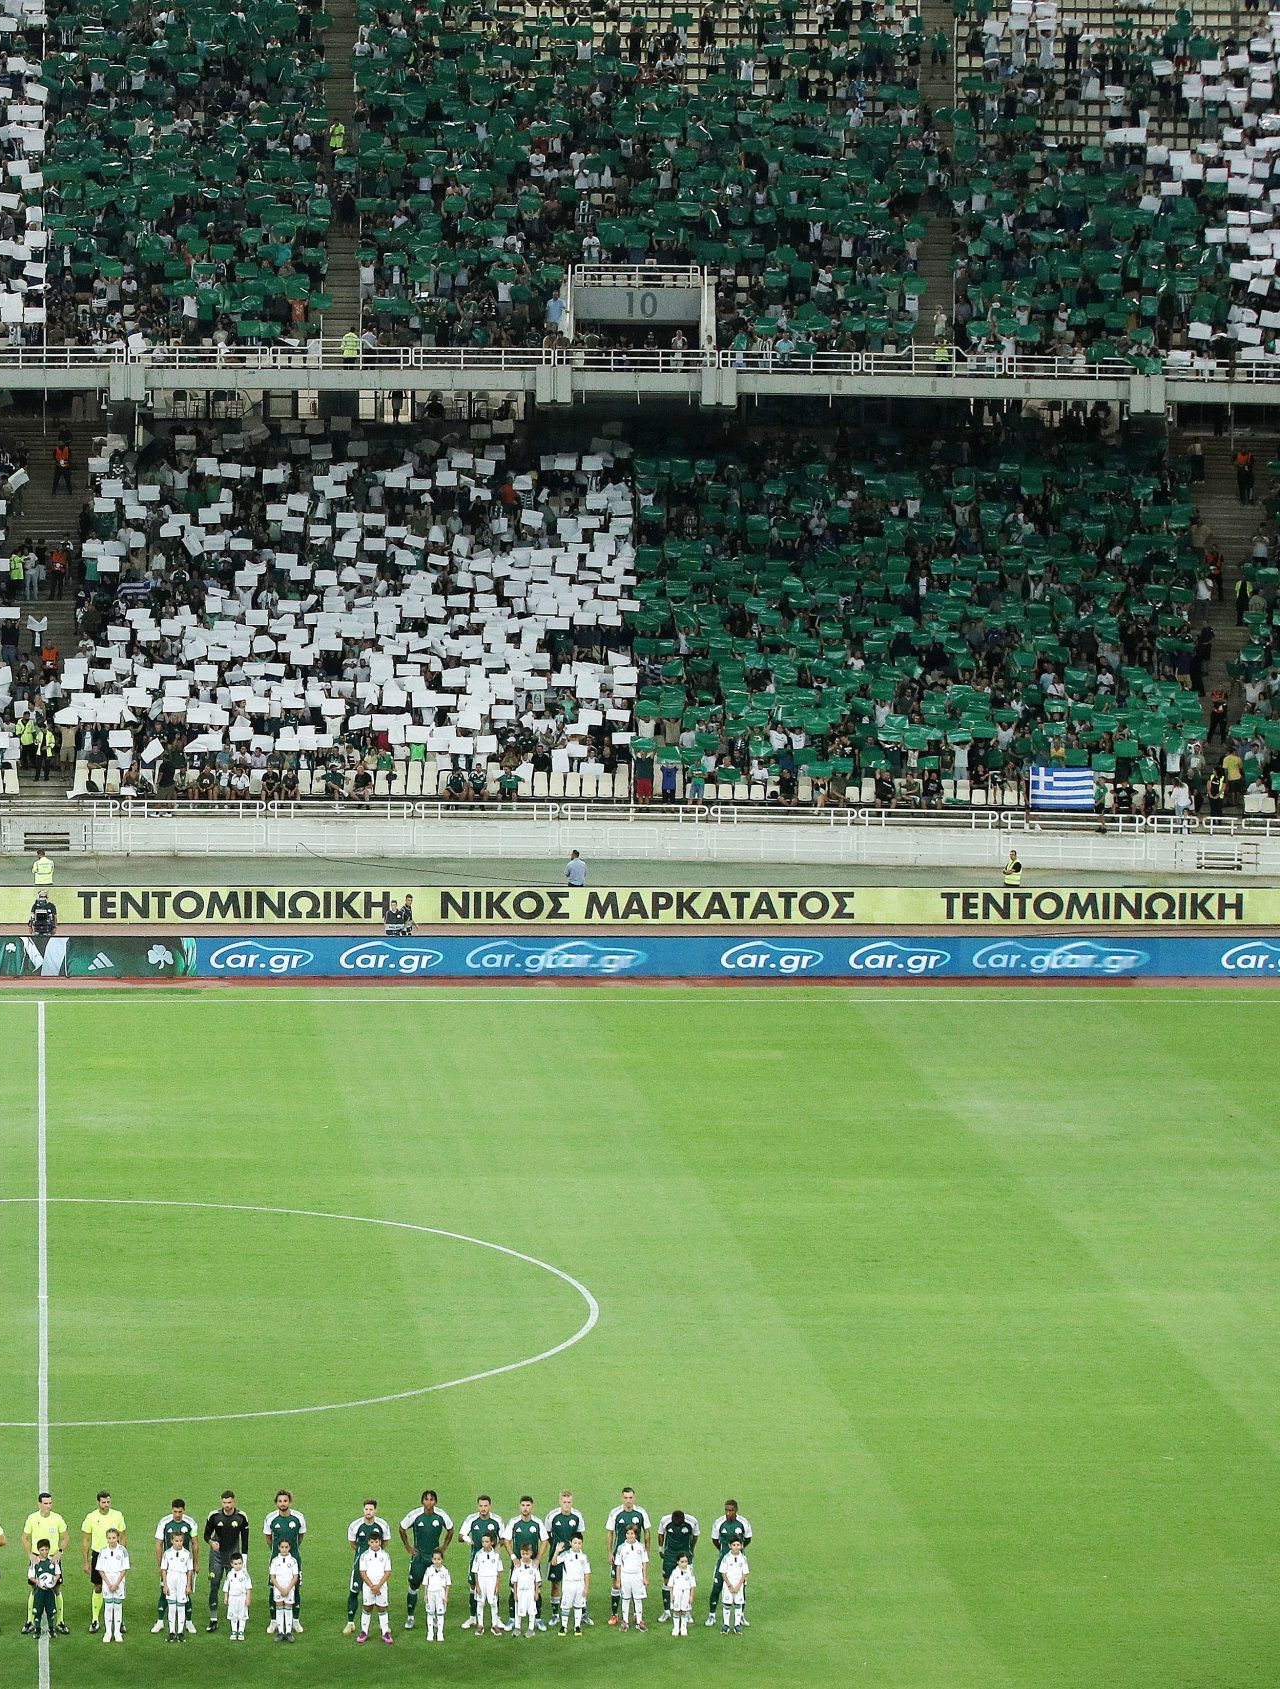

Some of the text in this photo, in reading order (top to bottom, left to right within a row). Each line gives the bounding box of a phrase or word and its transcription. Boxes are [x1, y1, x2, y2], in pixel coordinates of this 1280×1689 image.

[625, 291, 658, 318] 10
[77, 890, 854, 919] ΤΕΝΤΟΜΙΝΩΙΚΗ ΝΙΚΟΣ ΜΑΡΚΑΤΑΤΟΣ
[940, 891, 1243, 920] ΤΕΝΤΟΜΙΝΩΙΚΗ
